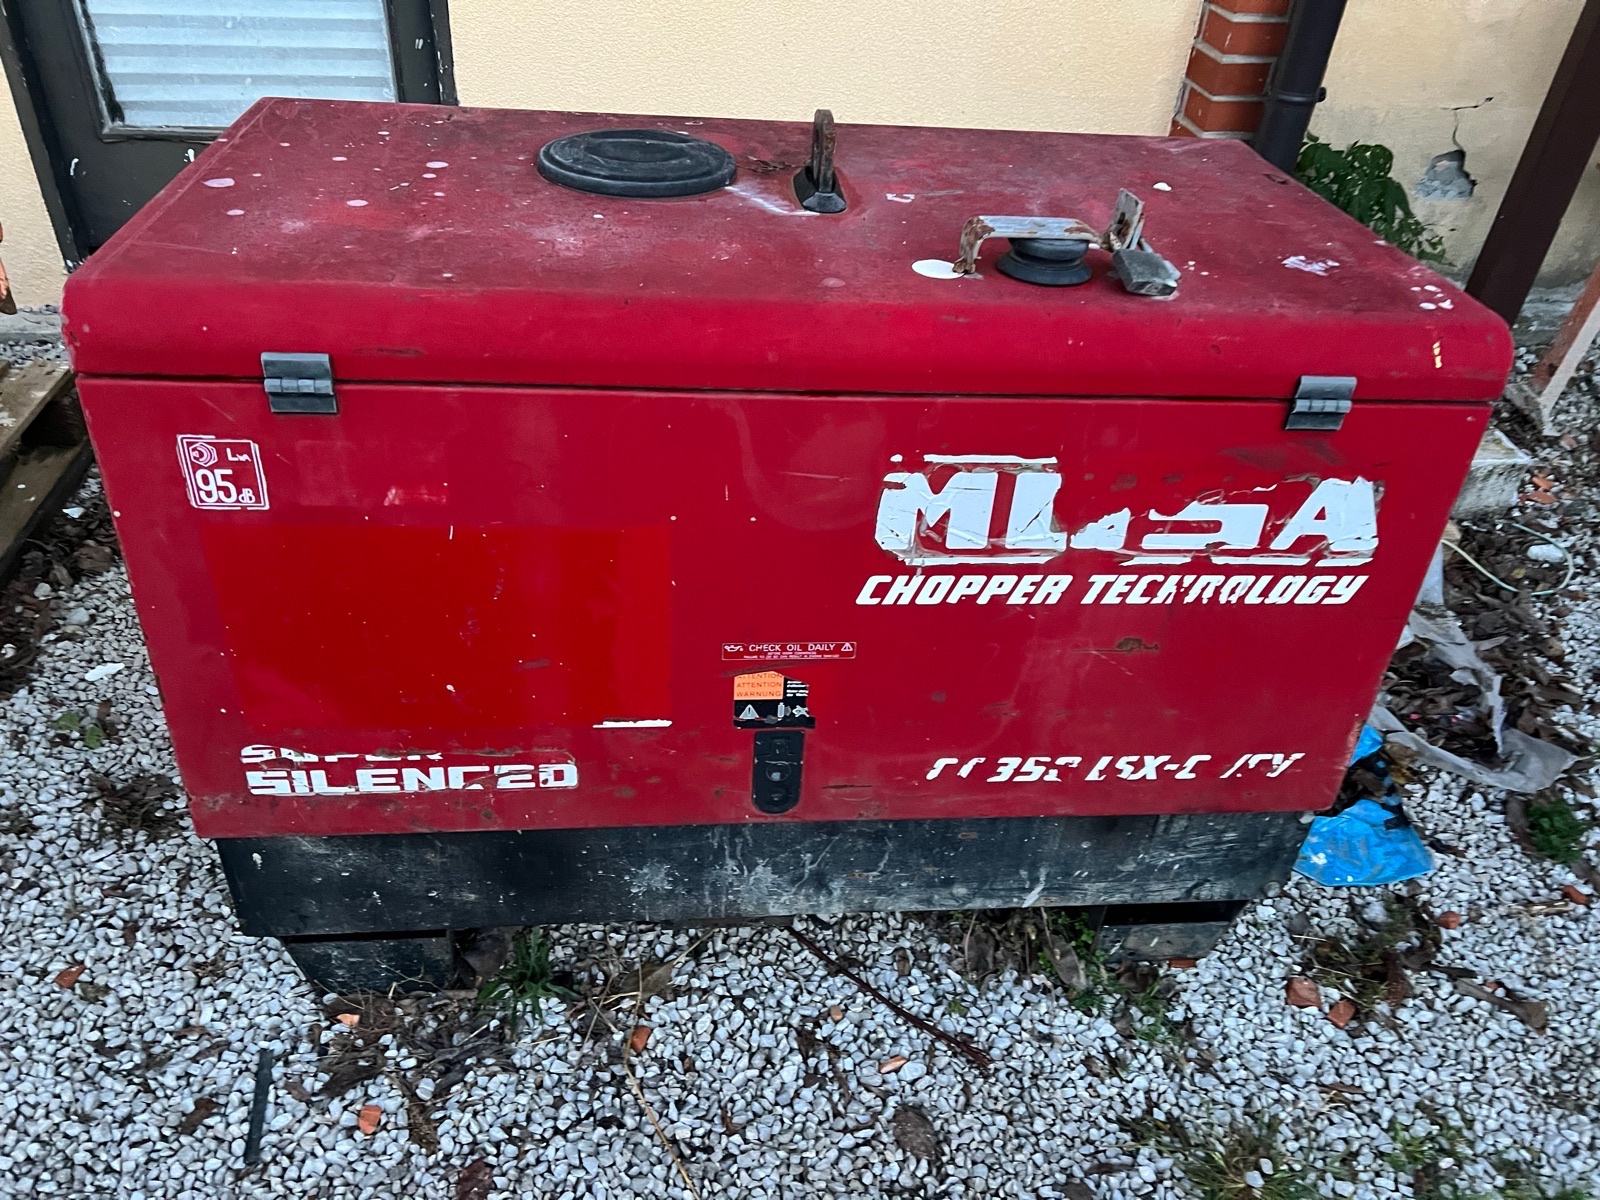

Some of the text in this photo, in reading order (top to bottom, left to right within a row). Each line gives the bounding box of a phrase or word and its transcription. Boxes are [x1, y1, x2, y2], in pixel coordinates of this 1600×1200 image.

[195, 468, 256, 503] 95 dB
[855, 574, 1074, 605] CHOPPER
[748, 643, 836, 652] CHECK OIL DAILY
